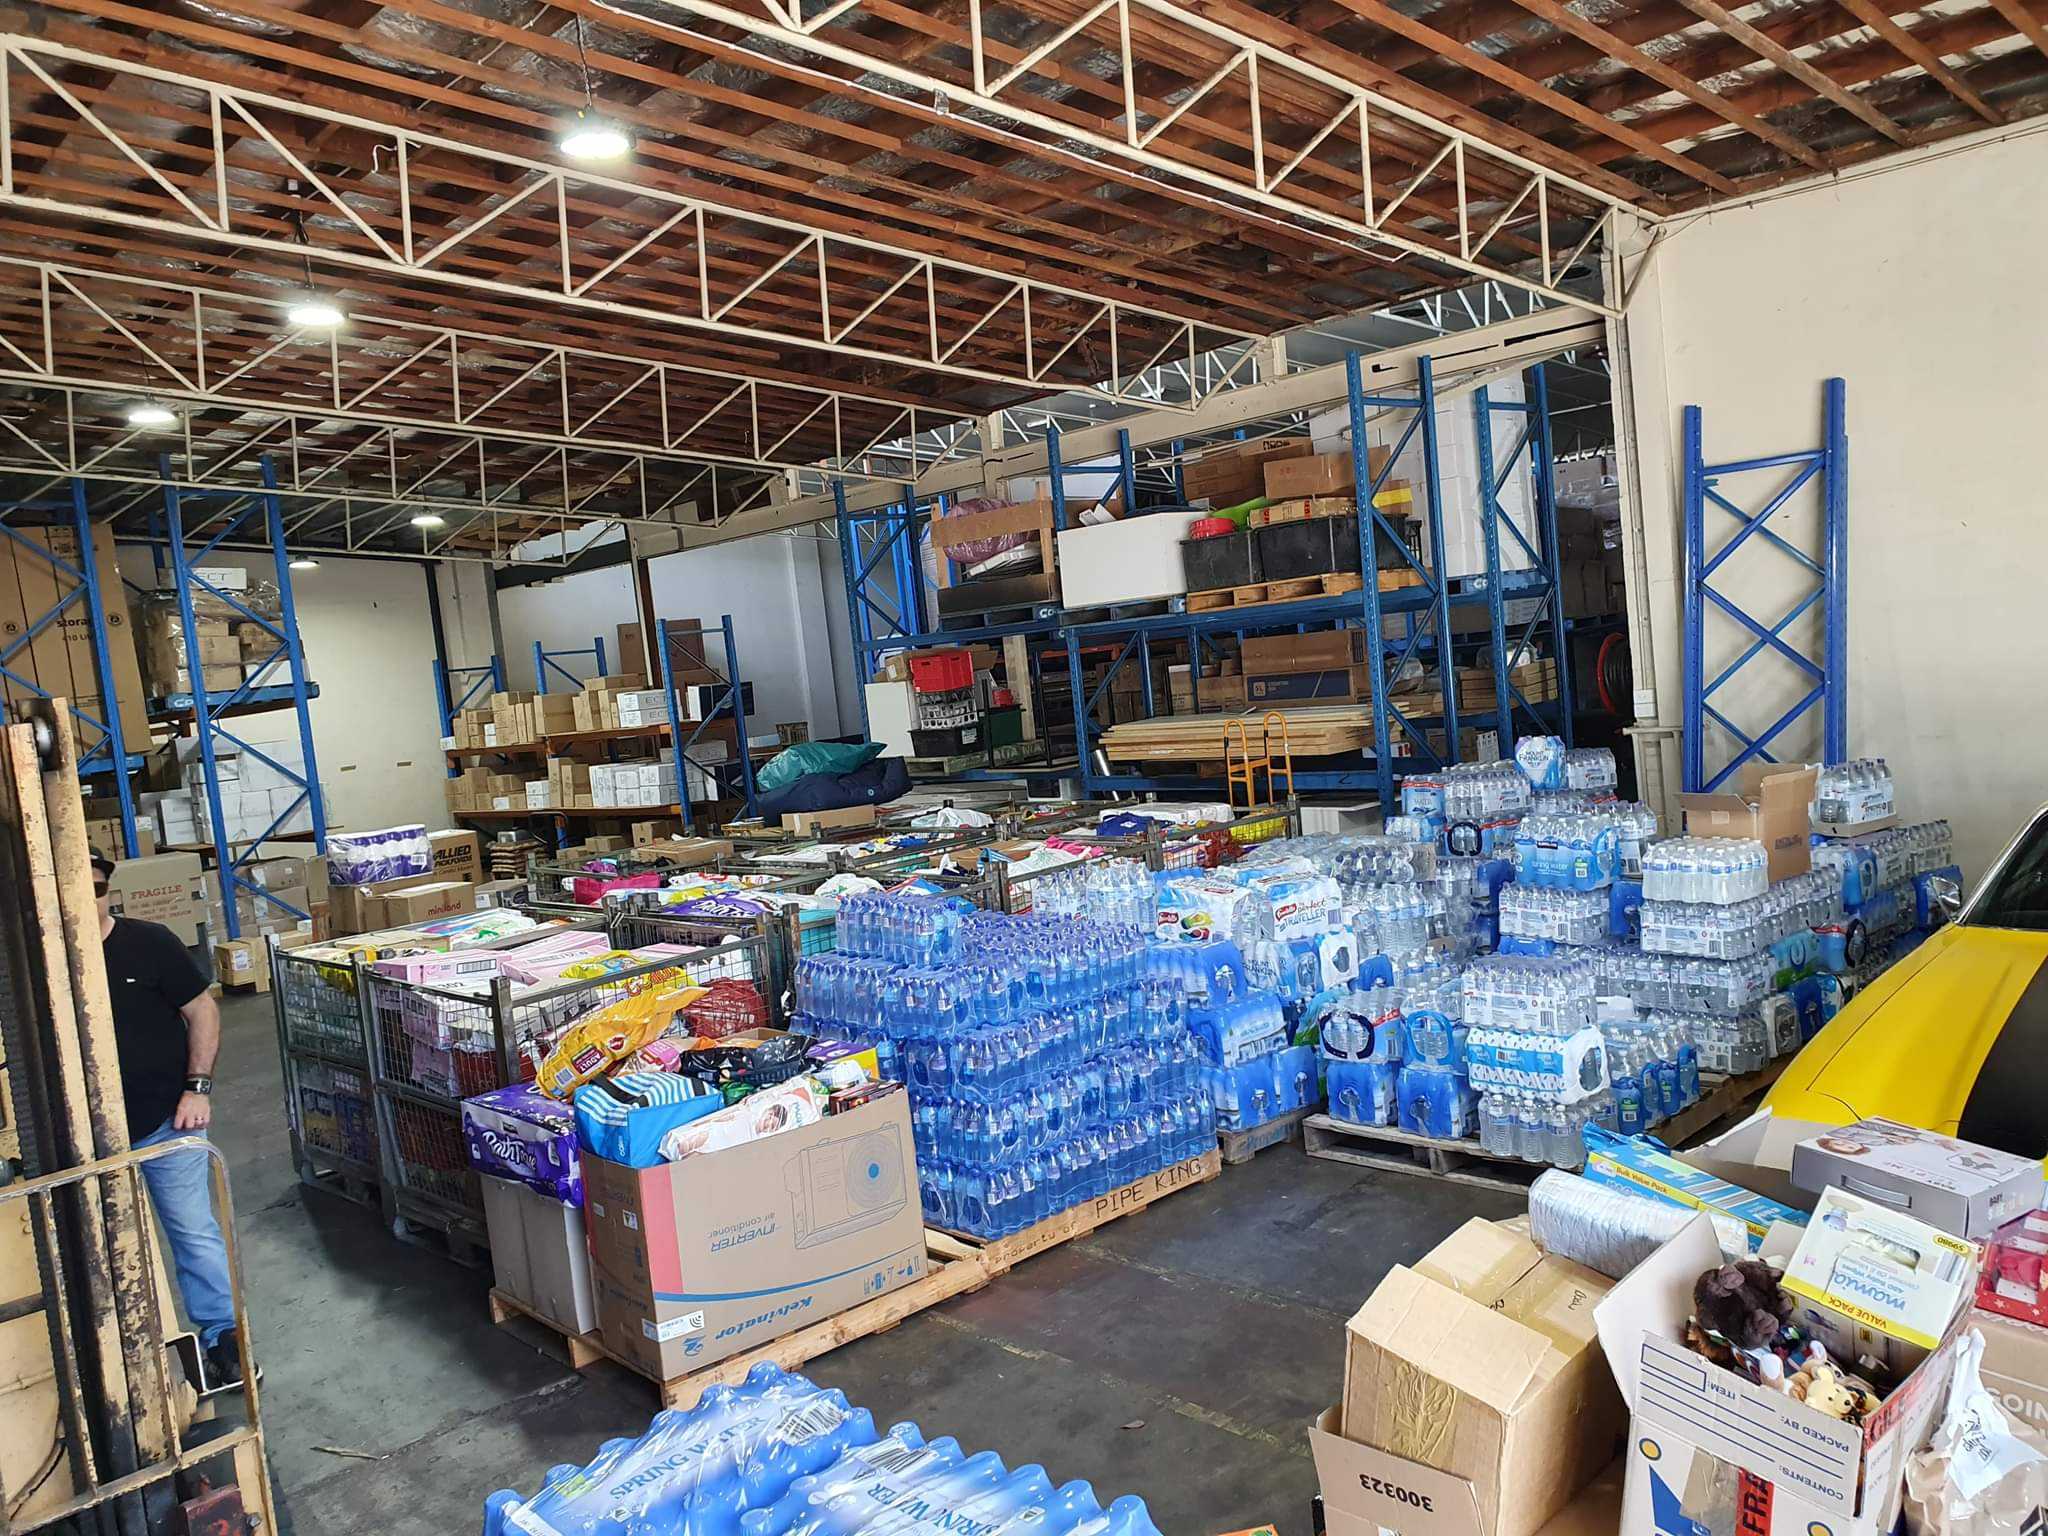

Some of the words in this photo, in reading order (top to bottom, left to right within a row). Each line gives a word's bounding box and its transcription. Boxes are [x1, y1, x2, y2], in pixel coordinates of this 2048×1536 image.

[433, 845, 472, 860] ALLIED
[131, 884, 183, 900] FRAGILE
[427, 901, 462, 917] miniland
[1095, 1182, 1144, 1219] PIPE
[1155, 1158, 1202, 1192] KING
[1615, 1166, 1631, 1179] Bulk
[1632, 1173, 1650, 1187] Value
[1651, 1181, 1669, 1194] Pack
[708, 1214, 761, 1240] conditioner
[711, 1223, 776, 1253] INVERTER
[1828, 1296, 1856, 1315] PACK
[1832, 1272, 1906, 1311] mamia
[715, 1295, 813, 1340] Kelvinator
[1856, 1308, 1888, 1329] VALUE
[1781, 1415, 1800, 1431] BY:
[1803, 1426, 1850, 1454] PACKED
[609, 1452, 690, 1500] SPRING
[1778, 1464, 1844, 1501] CONTENTS:
[1359, 1473, 1434, 1513] 300323
